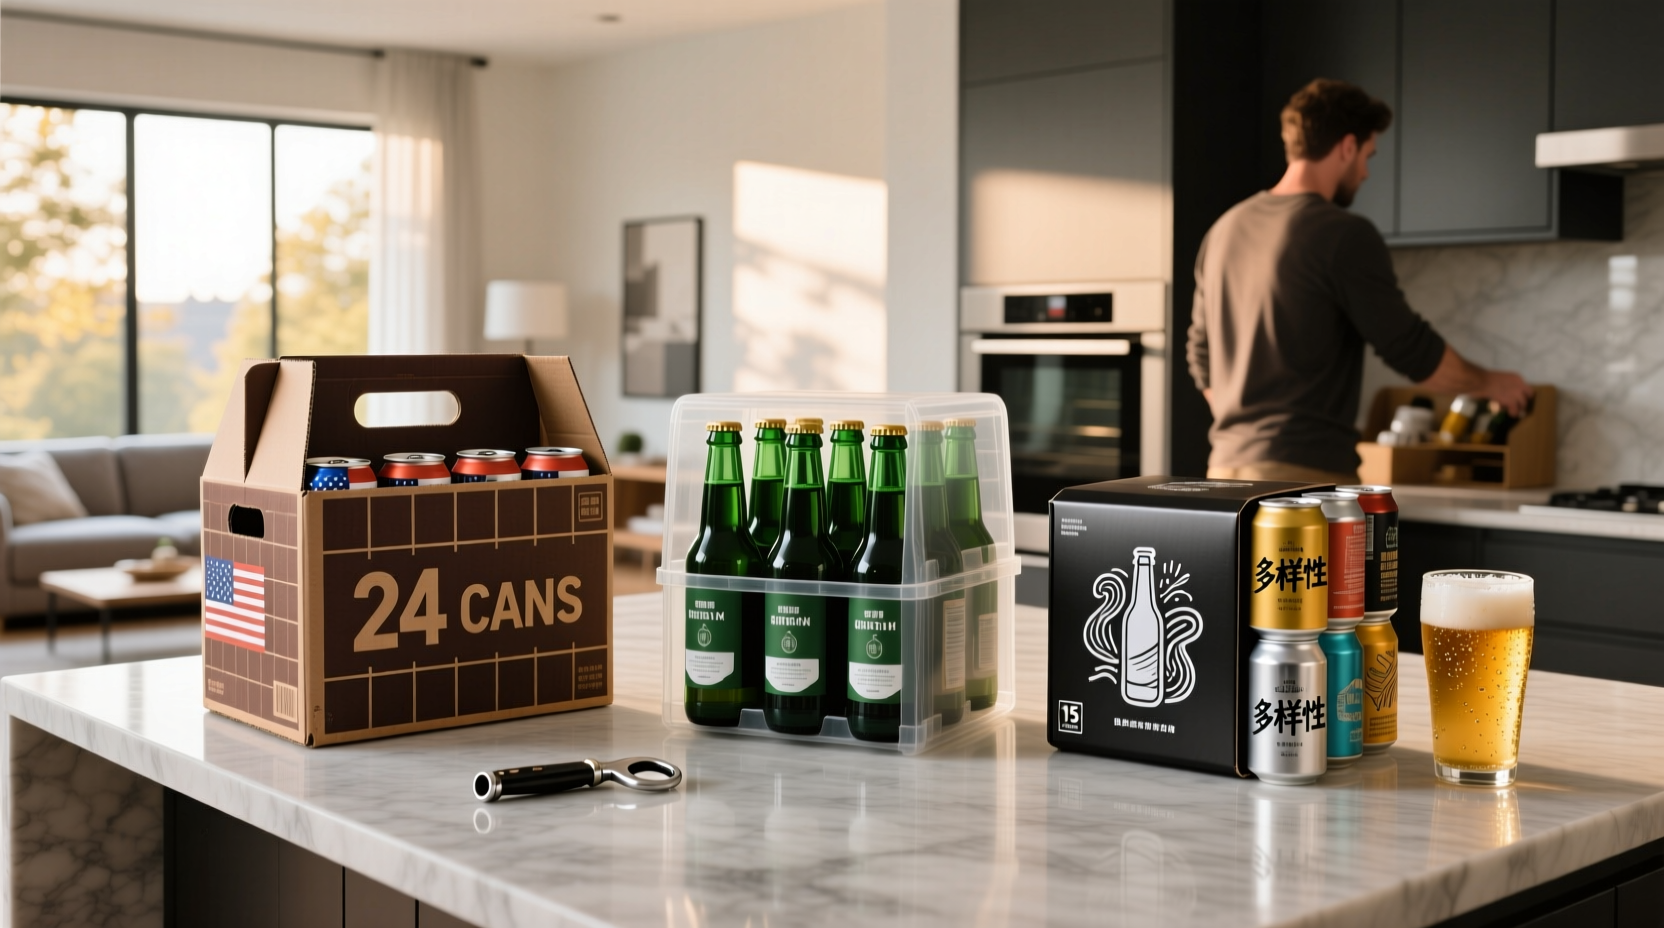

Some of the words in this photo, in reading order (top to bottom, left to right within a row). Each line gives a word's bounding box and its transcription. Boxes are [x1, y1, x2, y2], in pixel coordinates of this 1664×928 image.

[1254, 556, 1328, 594] 多样性
[353, 567, 448, 652] 24
[460, 575, 583, 634] CANS
[1061, 705, 1079, 723] 15
[1252, 695, 1326, 736] 多样性
